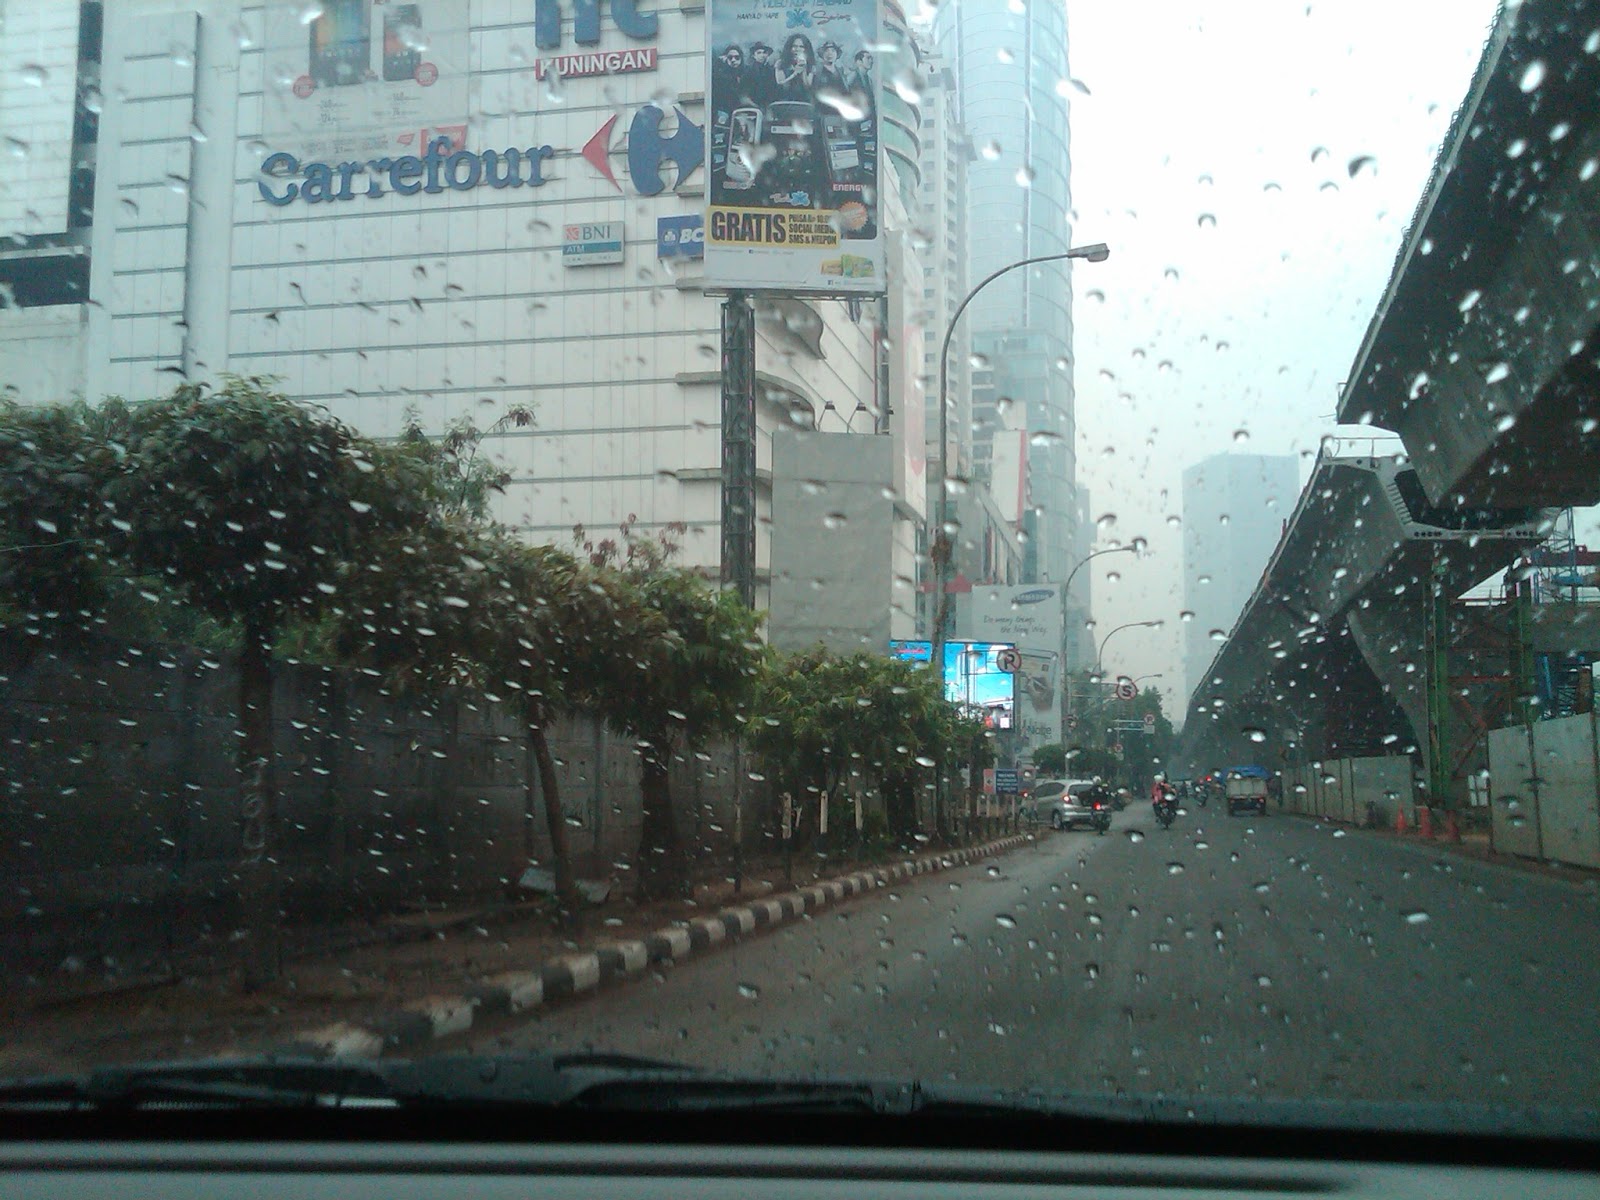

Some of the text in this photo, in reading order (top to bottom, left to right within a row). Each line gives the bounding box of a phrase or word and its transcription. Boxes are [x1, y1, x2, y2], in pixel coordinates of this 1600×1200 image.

[540, 49, 652, 77] KUNINGAN
[258, 135, 554, 207] Carrefour
[583, 225, 611, 240] BNI
[711, 211, 786, 243] GRATIS
[788, 223, 813, 234] SOCIAL
[680, 228, 705, 243] BC
[788, 234, 804, 244] SMS
[567, 245, 585, 254] ATM
[1003, 654, 1015, 670] P
[1122, 684, 1132, 697] S
